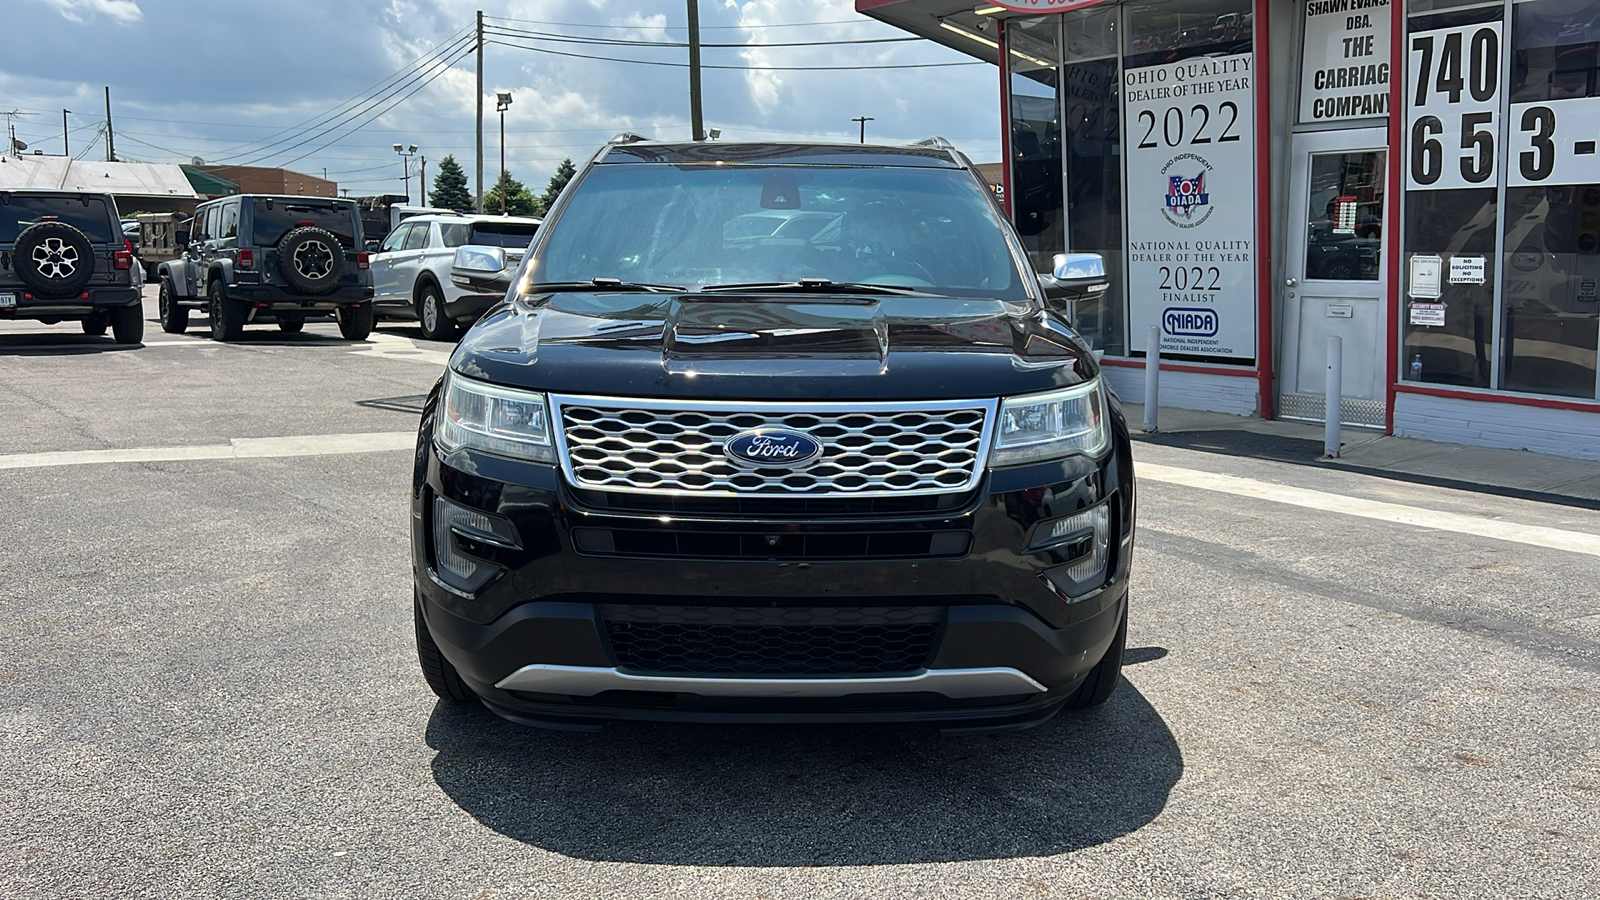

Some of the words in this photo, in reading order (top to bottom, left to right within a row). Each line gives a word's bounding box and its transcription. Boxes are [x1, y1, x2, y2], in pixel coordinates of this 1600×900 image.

[1308, 0, 1348, 16] SHAWN
[1346, 14, 1373, 30] DBA.
[1343, 35, 1374, 58] THE
[1126, 68, 1167, 86] OHIO
[1175, 57, 1251, 81] QUALITY
[1314, 63, 1390, 90] CARRIAG
[1412, 27, 1498, 107] 740
[1128, 87, 1171, 102] DEALER
[1173, 85, 1189, 97] OF
[1191, 81, 1214, 95] THE
[1217, 77, 1249, 92] YEAR
[1137, 101, 1240, 149] 2022
[1160, 159, 1174, 175] OHIO
[1173, 153, 1213, 171] INDEPENDENT
[1170, 194, 1201, 206] OIADA
[1131, 241, 1190, 251] NATIONAL
[1195, 241, 1251, 252] QUALITY
[1132, 253, 1172, 262] DEALER
[1176, 253, 1190, 262] OF
[1194, 253, 1215, 262] THE
[1220, 253, 1249, 262] YEAR
[1159, 266, 1221, 290] 2022
[1163, 293, 1216, 302] FINALIST
[1166, 313, 1213, 331] NIADA
[1187, 338, 1219, 346] INDEPENDENT
[746, 436, 800, 457] Ford
